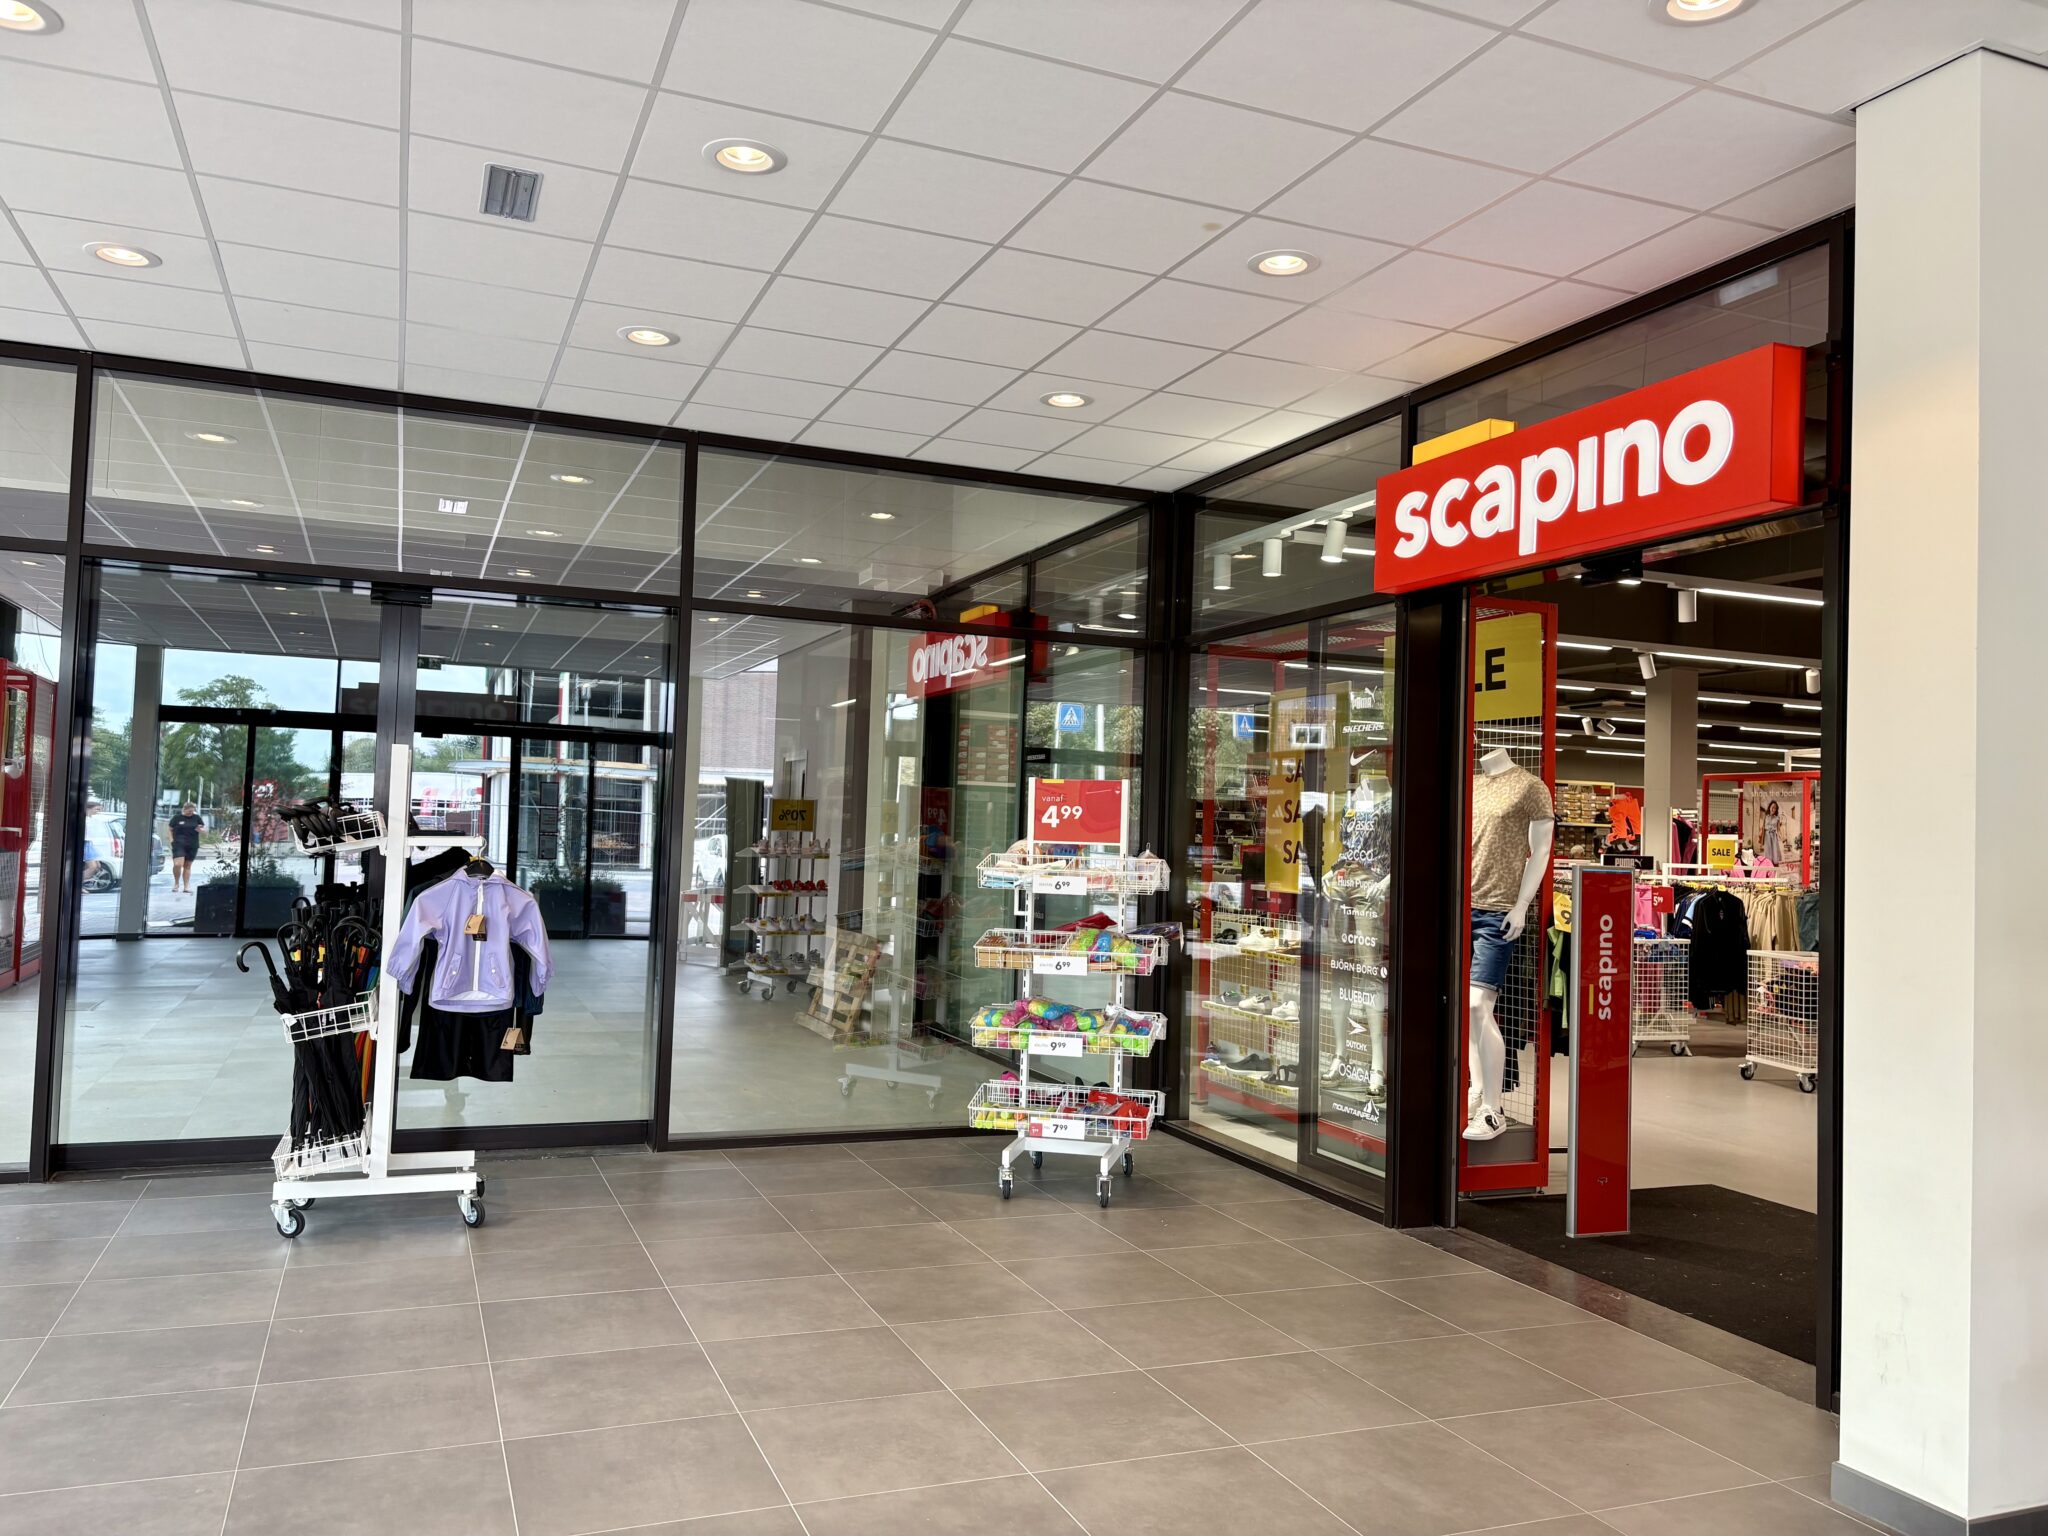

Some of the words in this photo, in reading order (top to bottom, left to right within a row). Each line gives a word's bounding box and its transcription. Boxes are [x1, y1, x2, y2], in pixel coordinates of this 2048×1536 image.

[1393, 399, 1735, 559] scapino
[1342, 723, 1383, 734] SKECHERS
[1041, 794, 1065, 802] vanaf
[1355, 820, 1375, 831] asics
[1346, 849, 1374, 861] ecco
[1711, 848, 1731, 857] SALE
[1337, 877, 1354, 888] Hush
[1355, 880, 1381, 891] Pupp
[1347, 934, 1376, 948] crocs
[1330, 959, 1355, 972] BJÖRN
[1356, 963, 1378, 976] BORG
[1598, 914, 1618, 1021] scapino
[1339, 988, 1376, 1008] BLUEBOX
[1332, 1102, 1380, 1123] MOUNTAINPEAK
